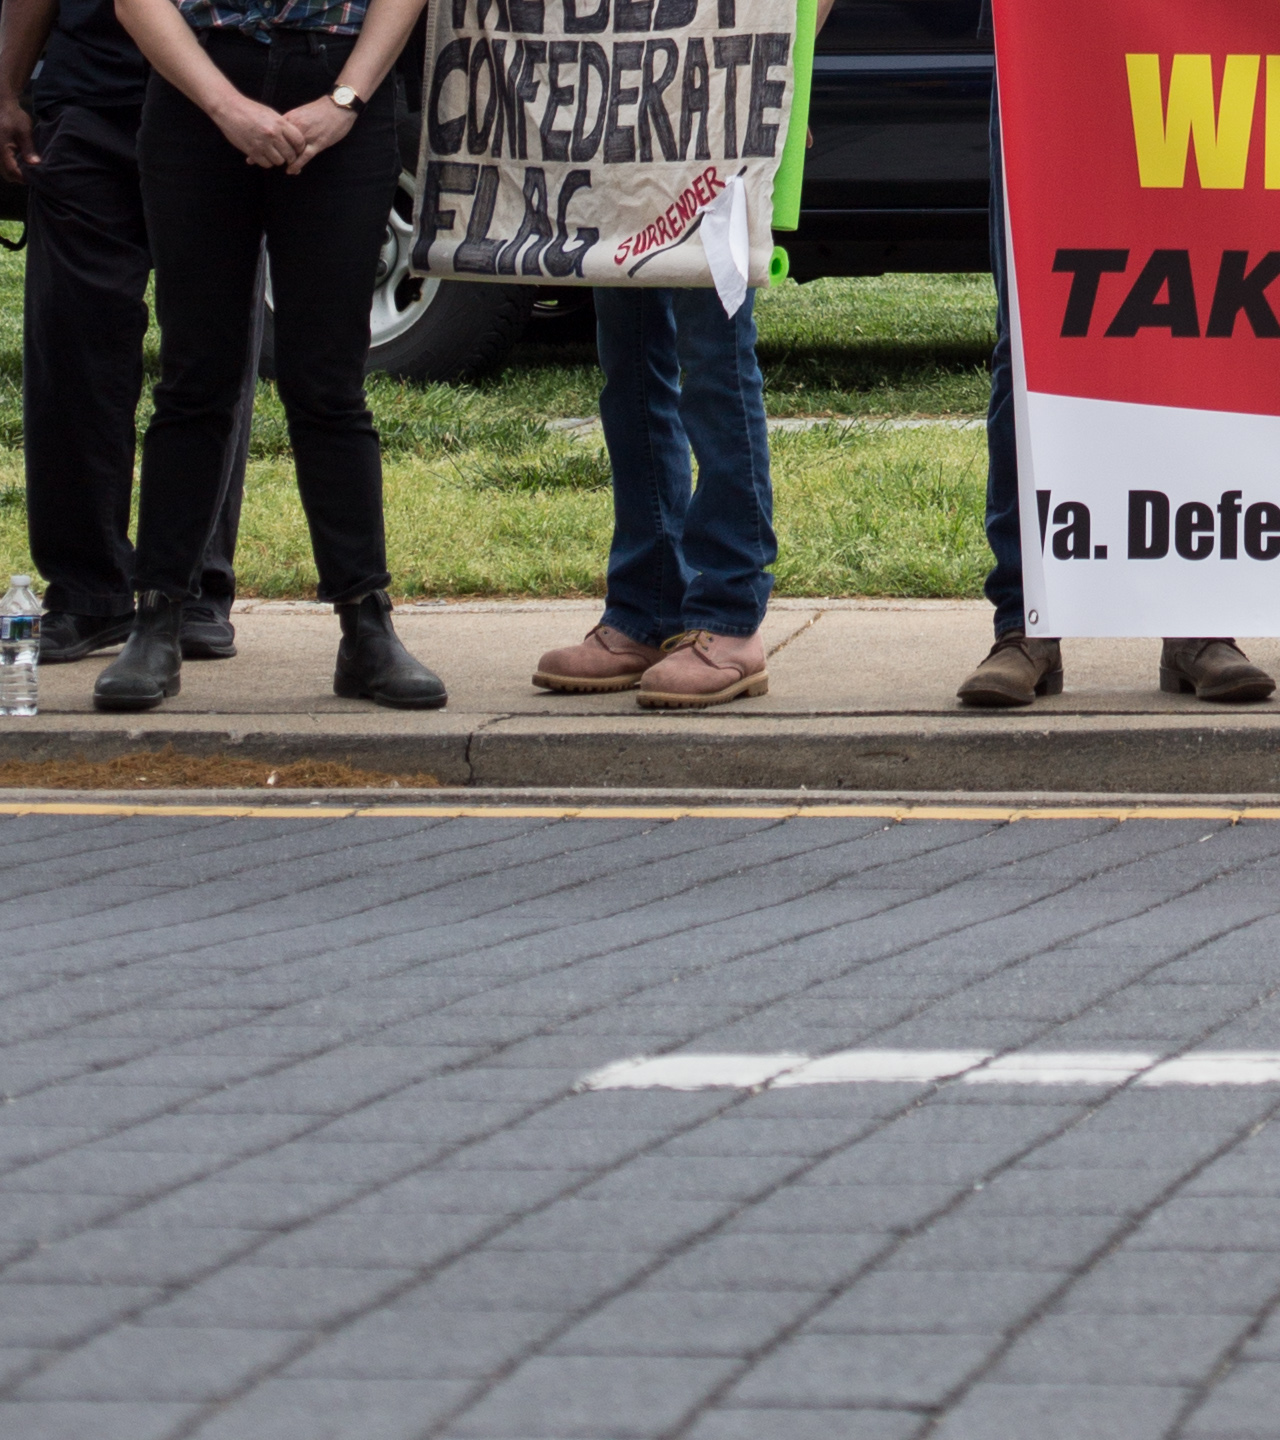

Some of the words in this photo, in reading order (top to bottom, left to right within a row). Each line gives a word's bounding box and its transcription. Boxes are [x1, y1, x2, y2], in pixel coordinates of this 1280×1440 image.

[427, 32, 791, 164] CONFEDERATE
[410, 160, 600, 278] FLAG
[614, 165, 727, 266] SURRENDER
